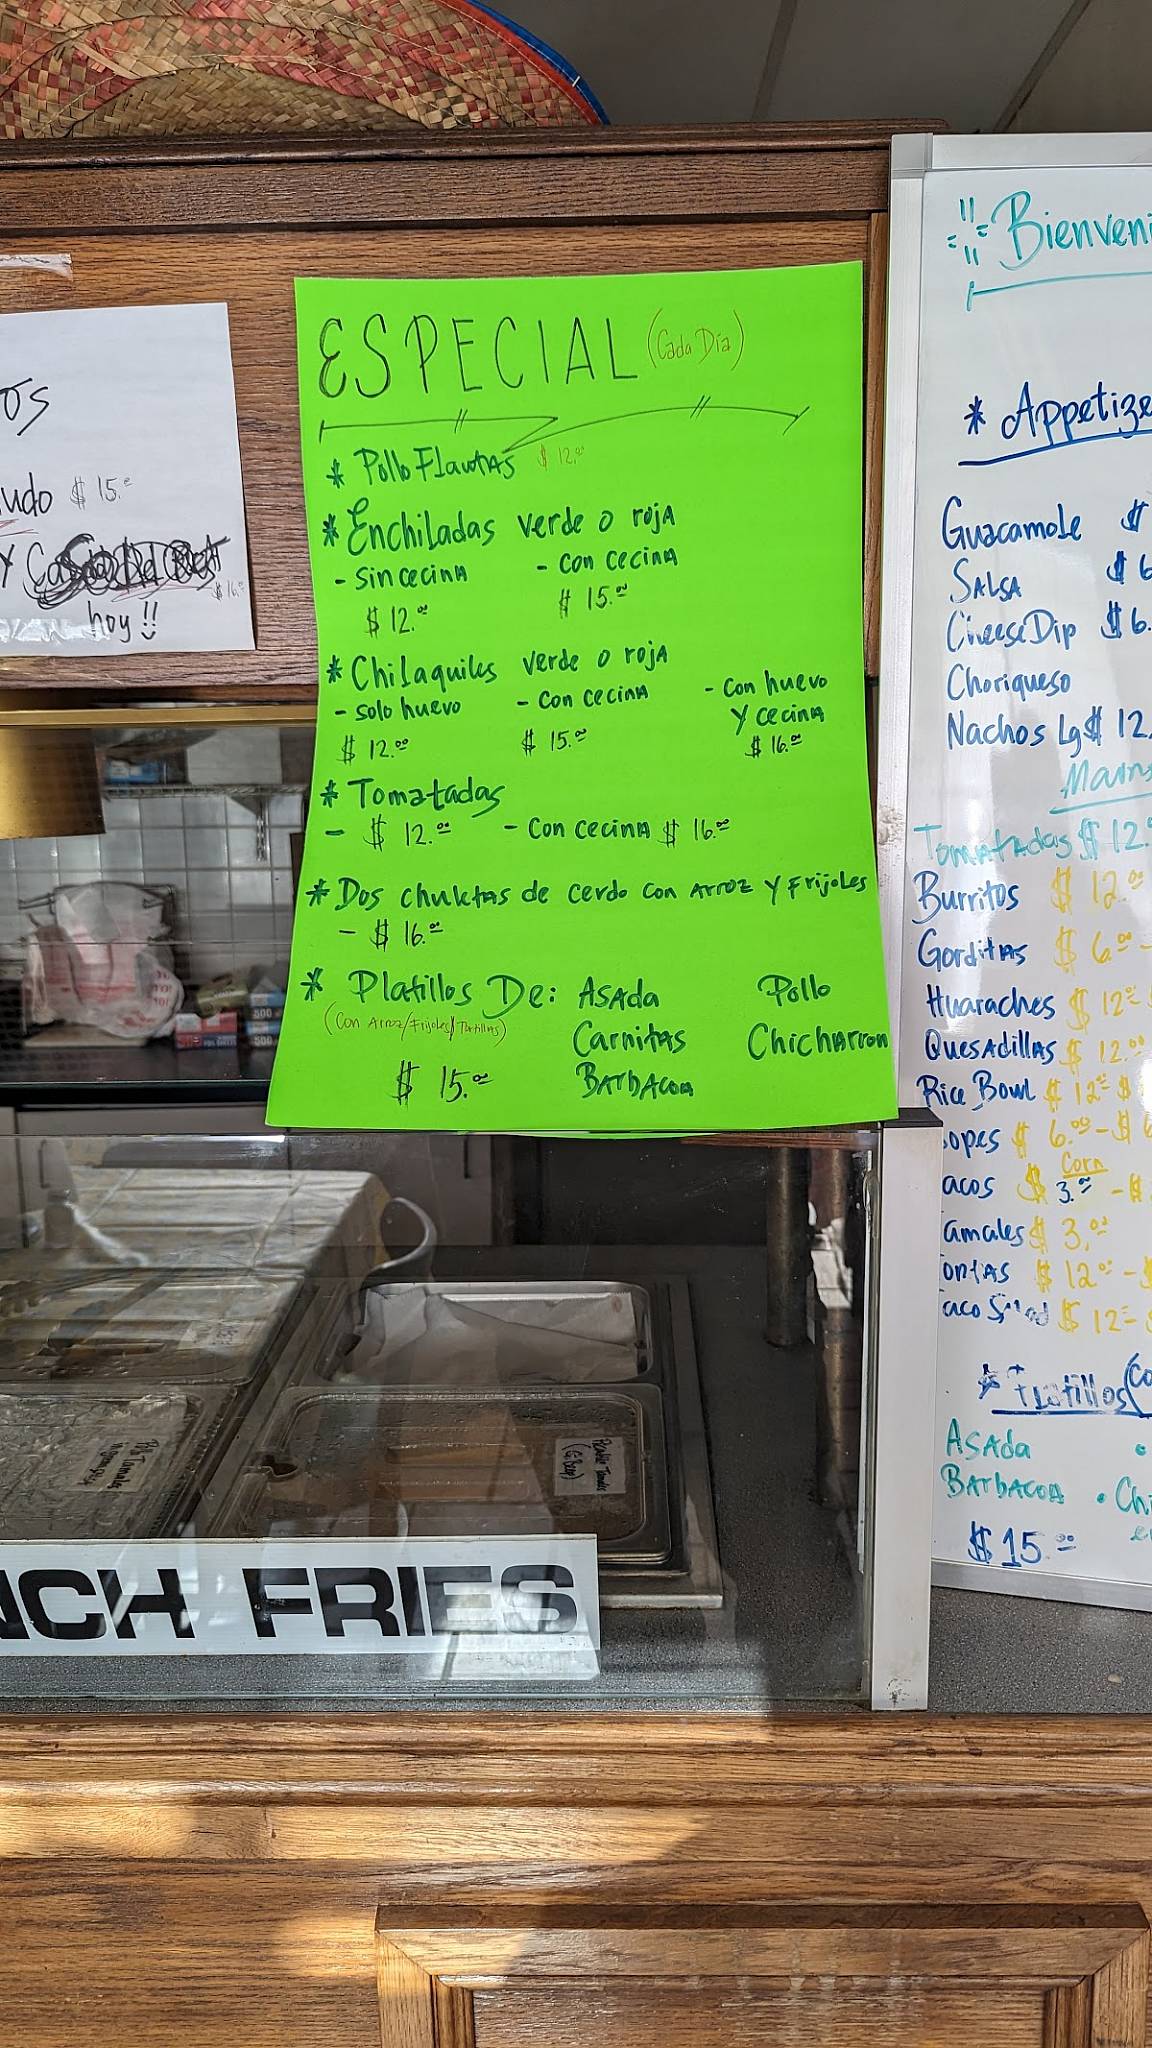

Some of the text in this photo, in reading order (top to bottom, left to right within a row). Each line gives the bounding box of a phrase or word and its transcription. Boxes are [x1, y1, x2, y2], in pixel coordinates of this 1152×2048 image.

[318, 313, 638, 398] ESPECIAL
[347, 497, 496, 556] Enchiladas
[942, 496, 1082, 550] Guacamole
[88, 600, 131, 644] hoy
[946, 663, 1071, 702] Choriqueso
[947, 709, 1046, 751] Nachos
[347, 776, 506, 819] Tomatadas
[912, 870, 1020, 925] Burritos
[348, 968, 474, 1007] Platillos
[757, 972, 832, 1007] Pollo
[926, 983, 1056, 1021] Huaraches
[916, 1074, 967, 1108] Rice
[971, 1069, 1037, 1111] Bowl
[242, 1564, 578, 1639] FRIES
